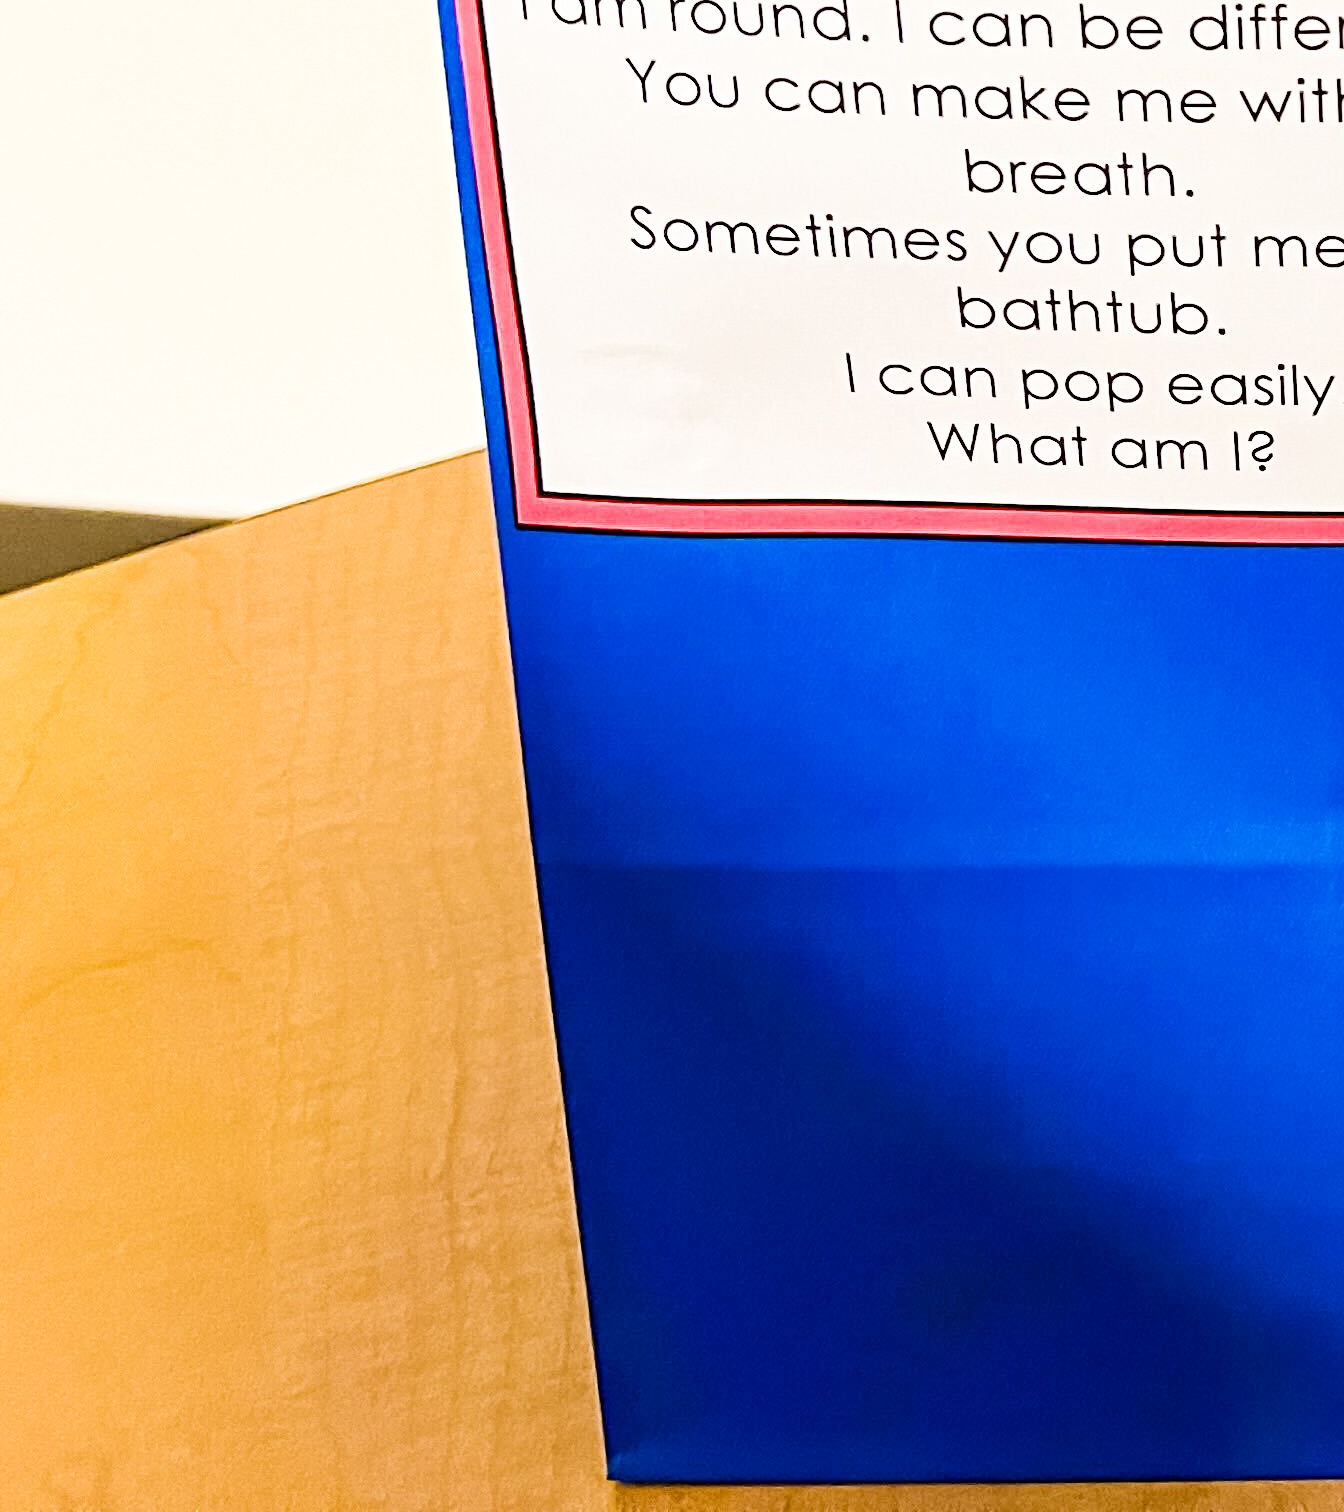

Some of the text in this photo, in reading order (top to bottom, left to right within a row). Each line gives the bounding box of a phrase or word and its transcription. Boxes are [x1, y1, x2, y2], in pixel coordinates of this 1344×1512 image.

[928, 11, 1054, 49] can
[1078, 2, 1164, 51] be
[624, 57, 739, 109] You
[764, 77, 887, 116] can
[912, 74, 1091, 122] make
[1116, 88, 1217, 124] me
[964, 148, 1195, 198] breath.
[629, 204, 968, 262] Sometimes
[986, 230, 1101, 273] you
[1127, 223, 1227, 277] put
[956, 285, 1227, 336] bathtub.
[845, 352, 856, 393] I
[878, 363, 997, 399] can
[1021, 368, 1144, 413] pop
[926, 420, 1275, 472] What am I?
